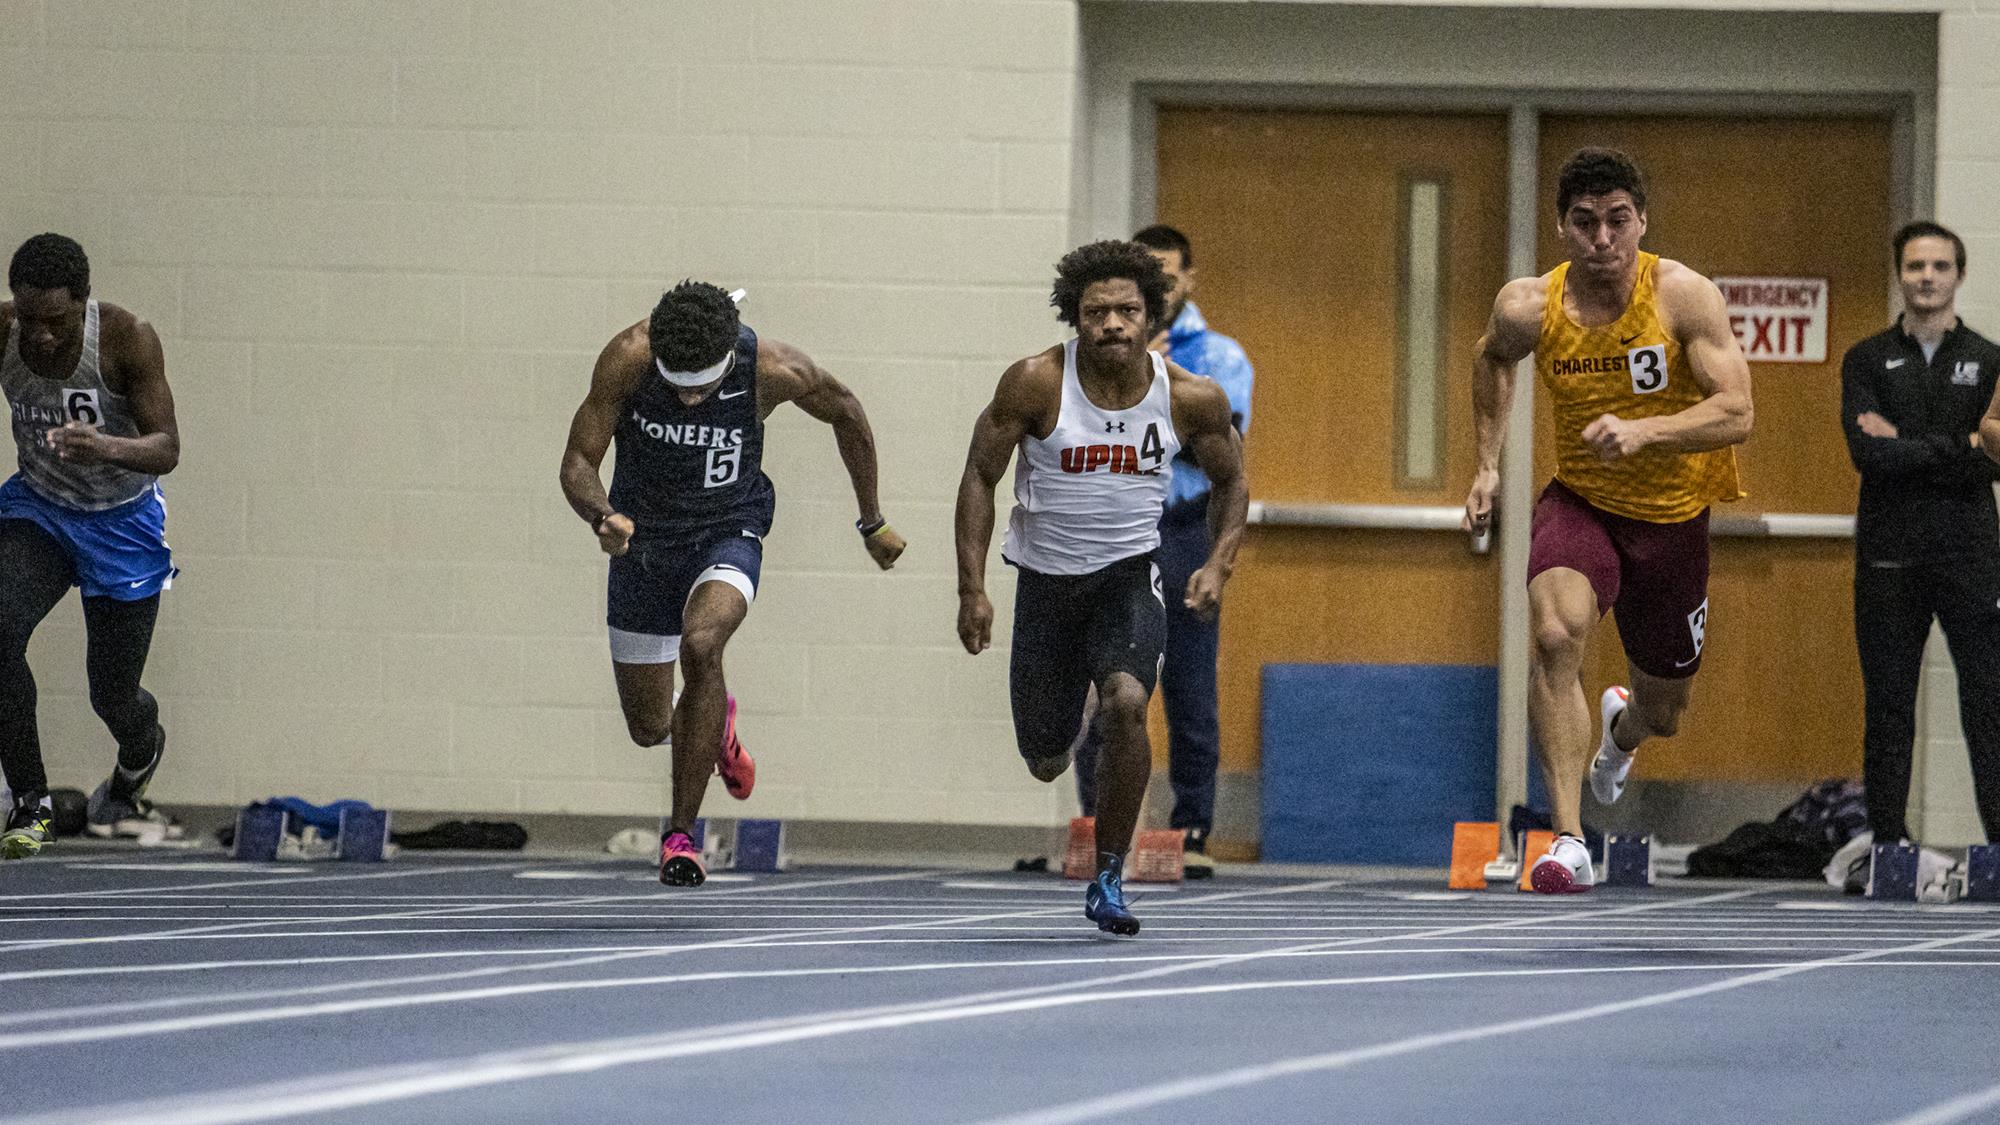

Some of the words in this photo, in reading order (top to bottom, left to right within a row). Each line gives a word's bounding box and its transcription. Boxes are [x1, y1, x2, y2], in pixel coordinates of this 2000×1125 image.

[1729, 316, 1811, 353] EXIT
[1634, 350, 1662, 390] 3
[68, 392, 97, 425] 6
[1141, 422, 1165, 468] 4
[709, 448, 735, 483] 5
